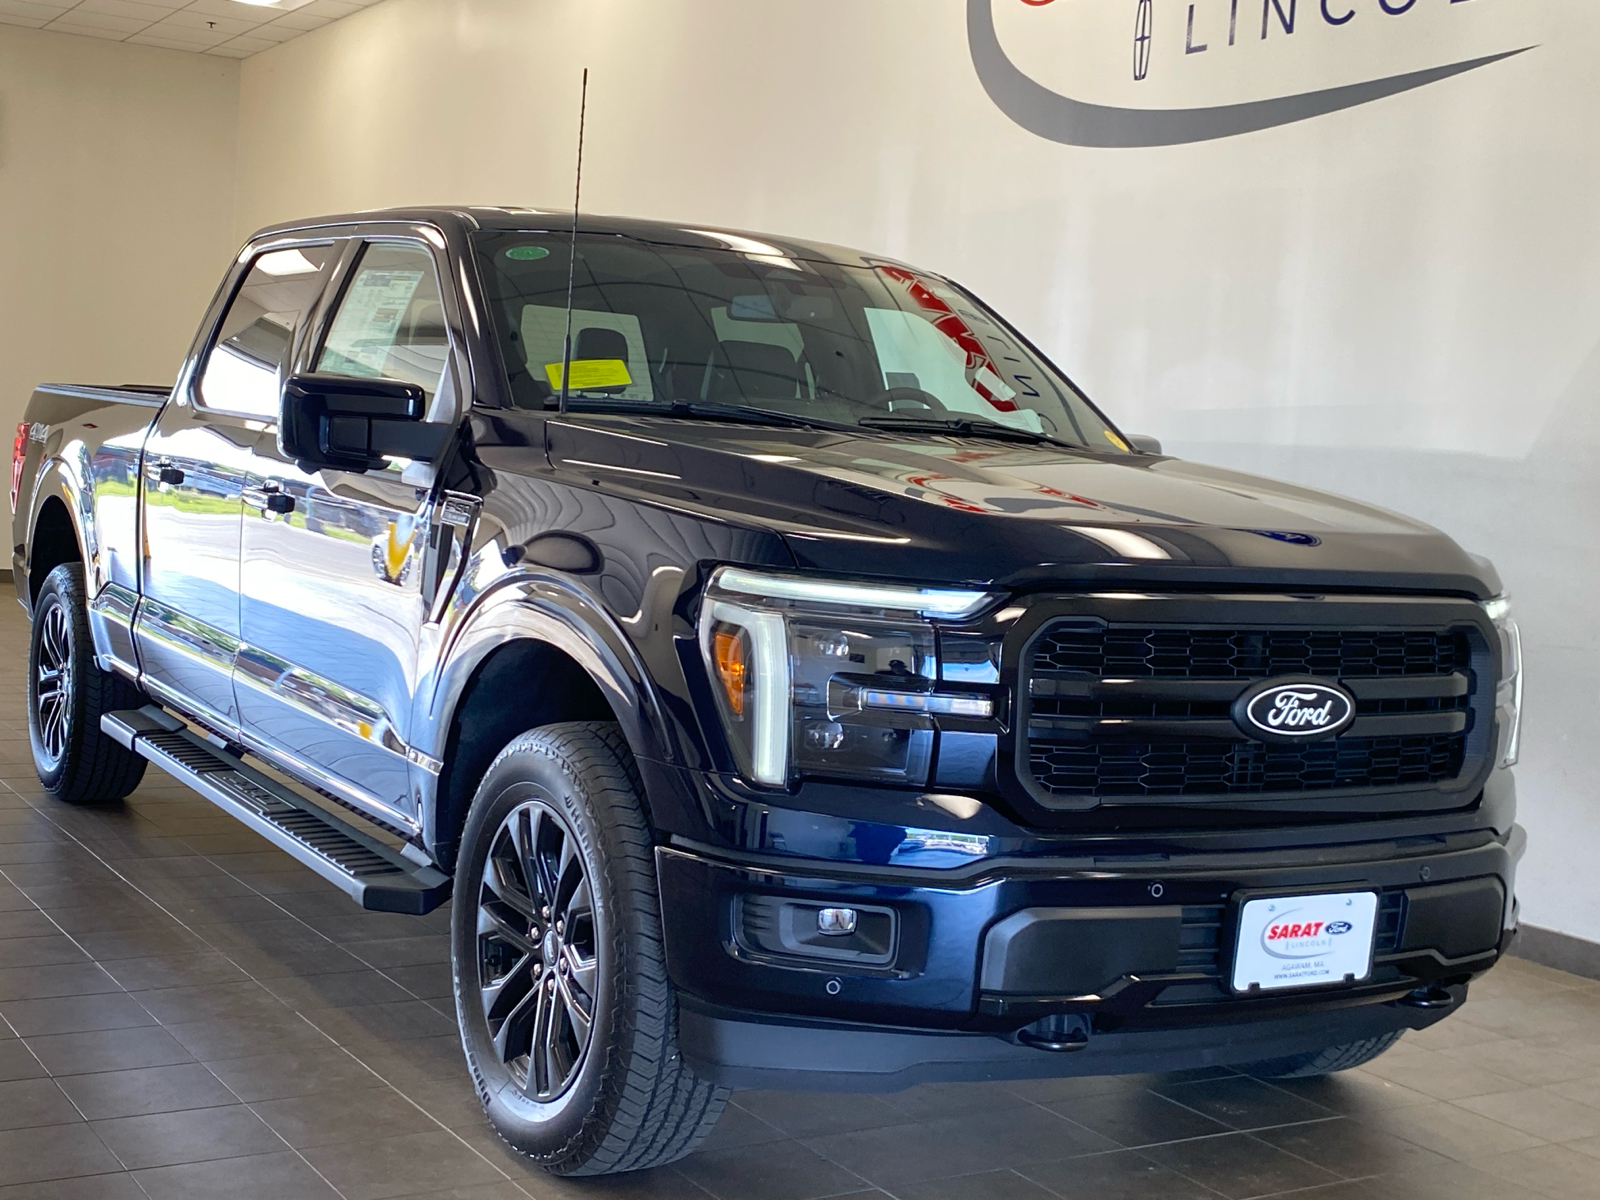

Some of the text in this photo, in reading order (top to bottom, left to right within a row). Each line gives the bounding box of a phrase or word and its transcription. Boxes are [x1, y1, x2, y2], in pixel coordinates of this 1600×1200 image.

[1267, 691, 1332, 726] Ford
[1267, 921, 1324, 940] SARAT
[1292, 940, 1327, 949] LINCOLN
[1282, 962, 1312, 971] AGAWAM,
